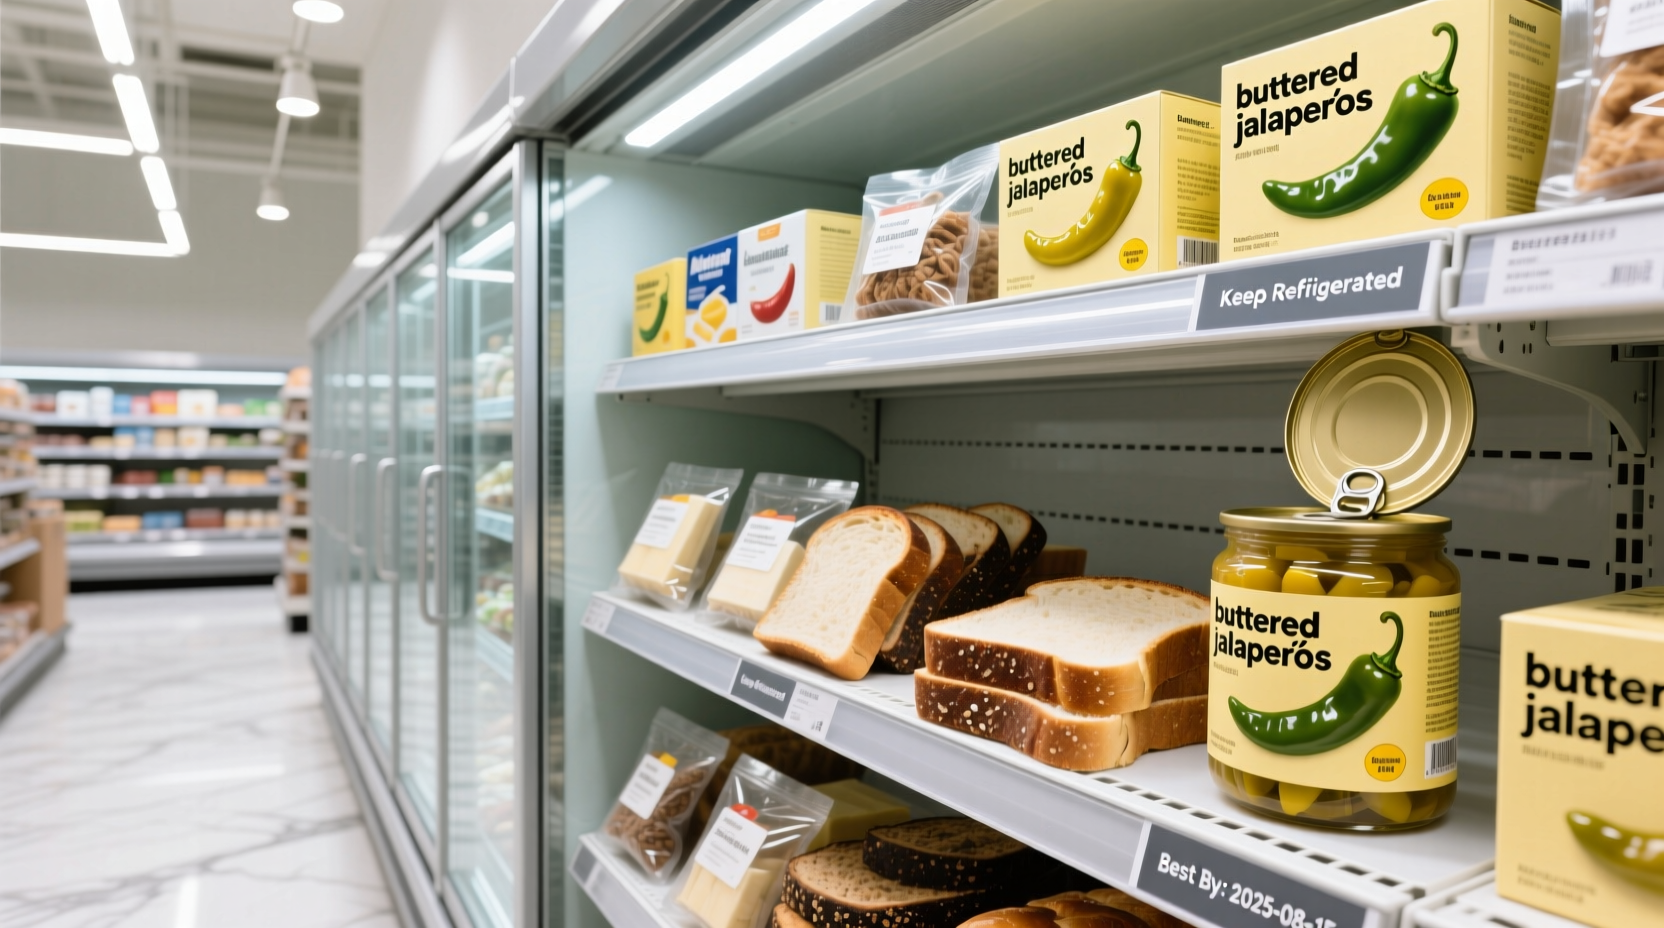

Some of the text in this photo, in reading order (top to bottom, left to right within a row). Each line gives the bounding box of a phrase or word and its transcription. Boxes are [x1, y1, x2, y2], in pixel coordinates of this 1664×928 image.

[1237, 52, 1358, 109] buttered
[1009, 136, 1084, 178] buttered
[1219, 289, 1267, 309] Keep
[1215, 596, 1320, 639] buttered
[1520, 692, 1664, 755] jalape
[1157, 852, 1197, 884] Best
[1198, 868, 1228, 899] By:
